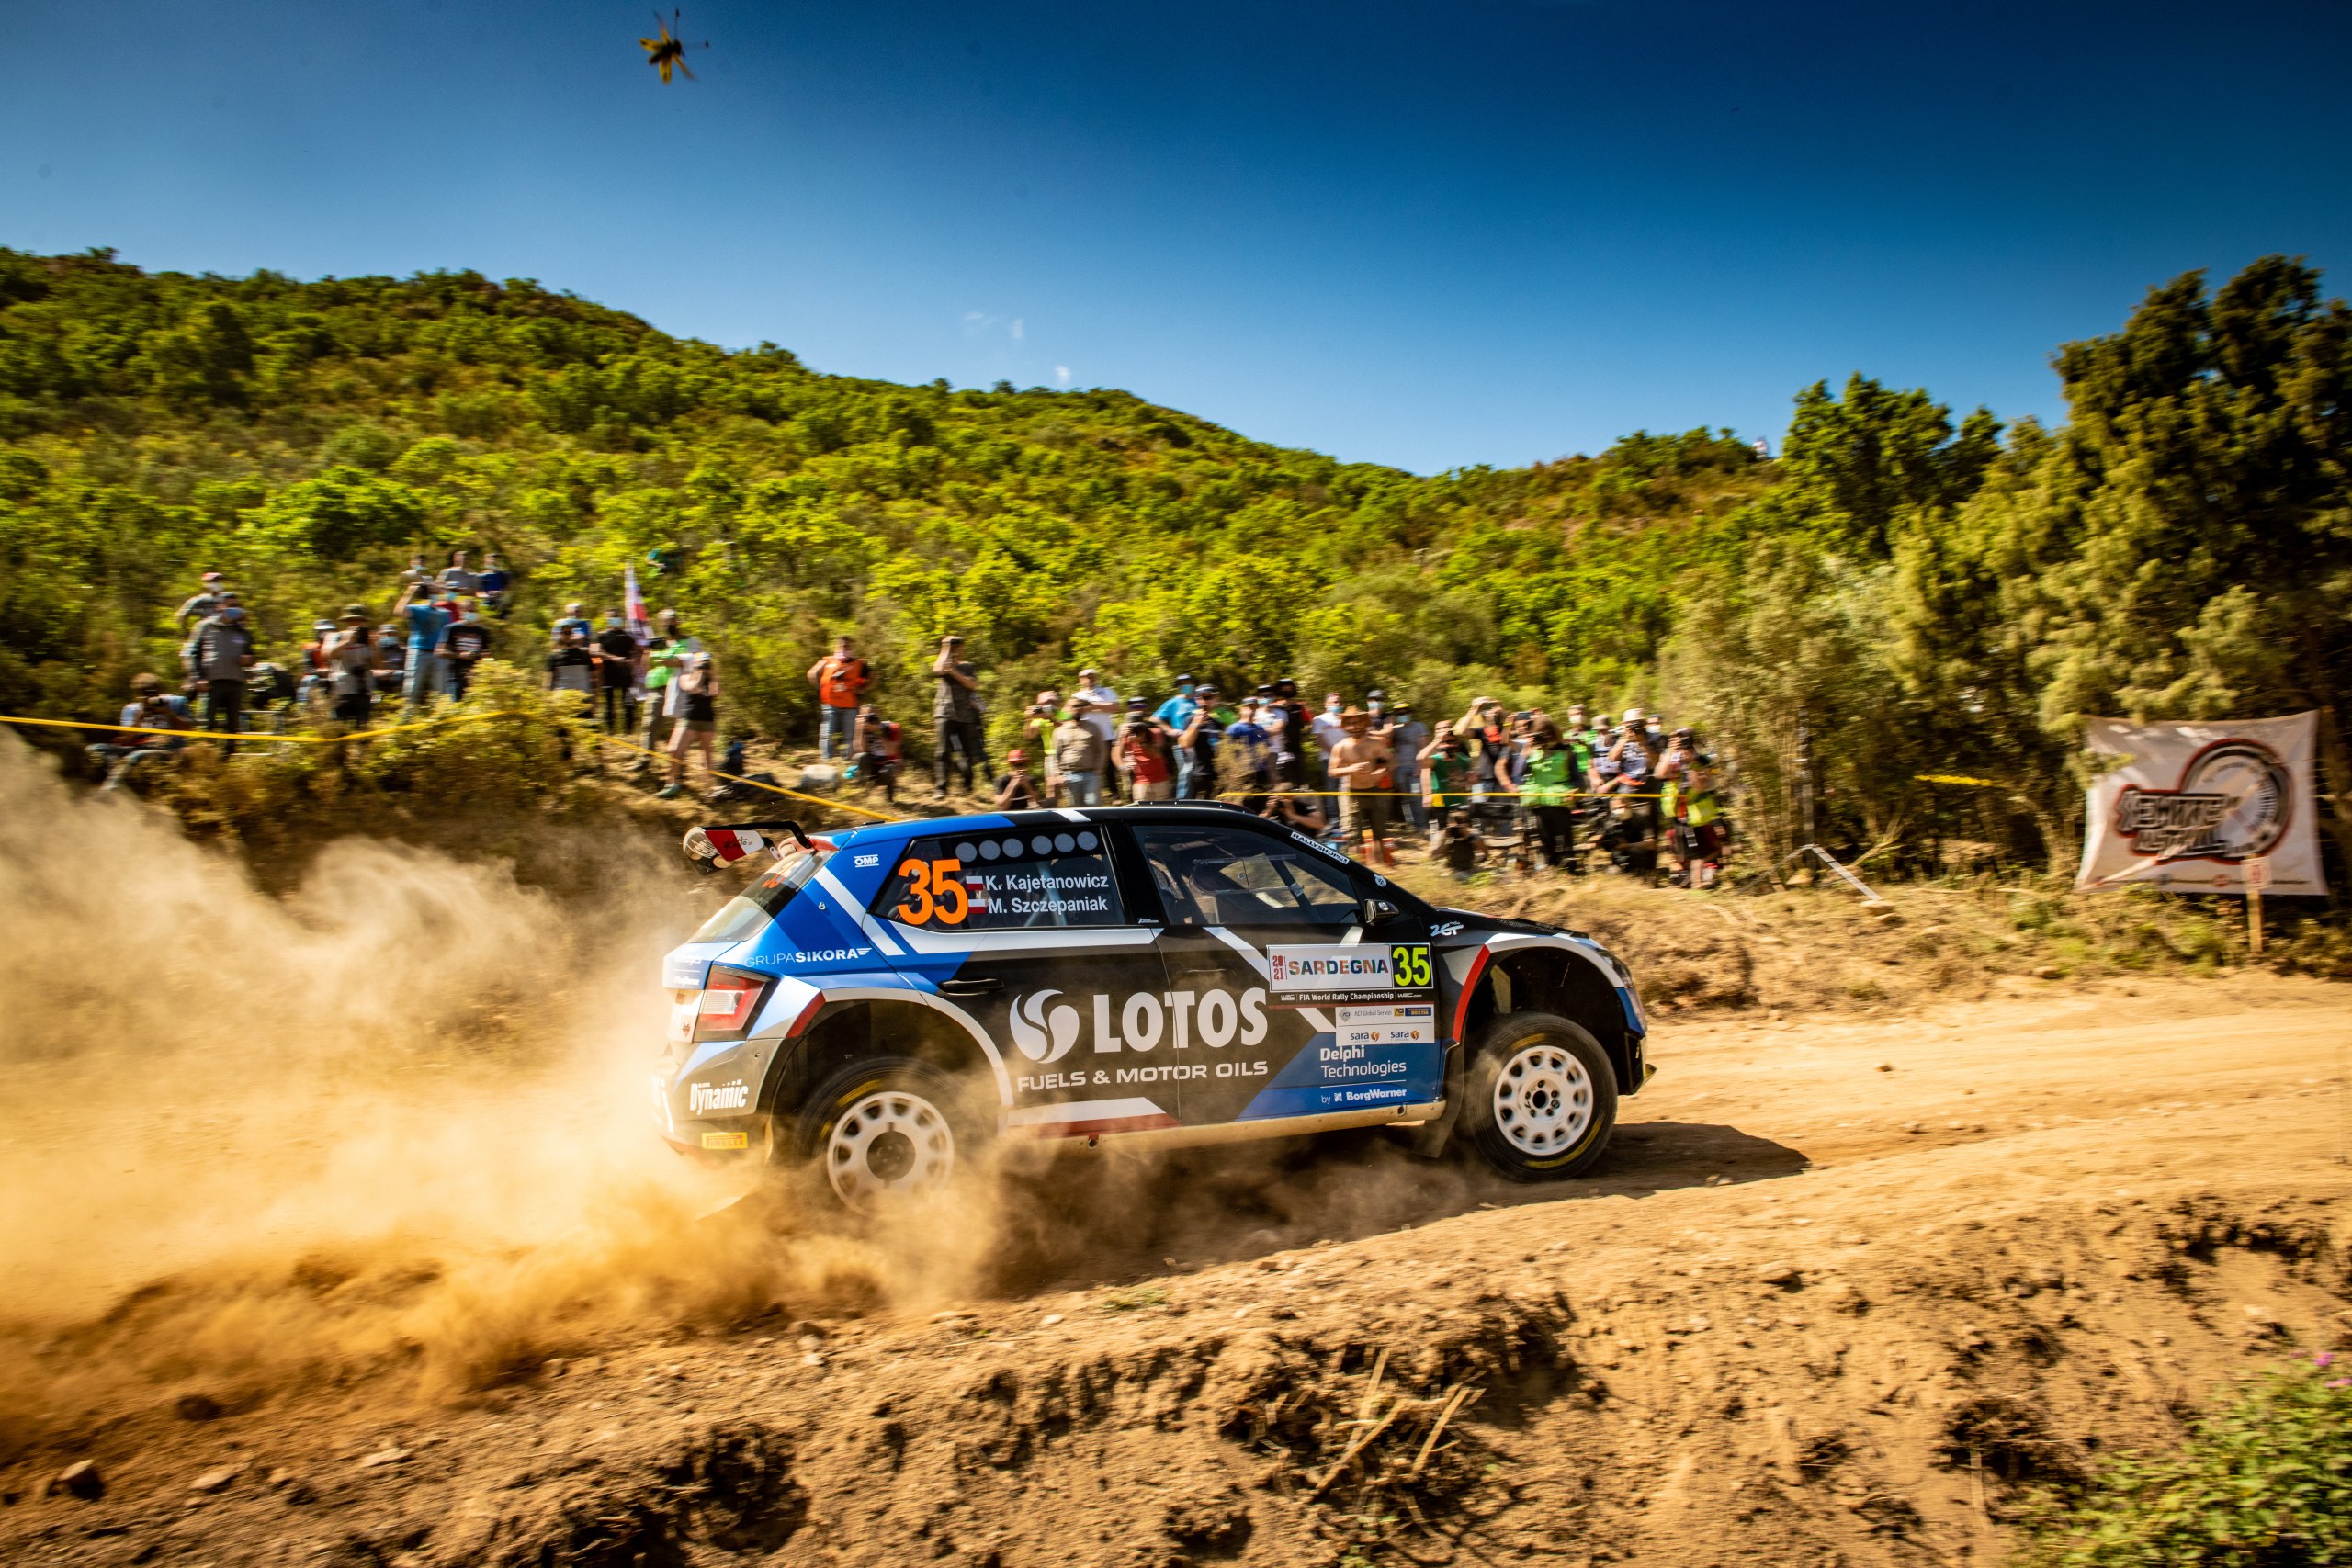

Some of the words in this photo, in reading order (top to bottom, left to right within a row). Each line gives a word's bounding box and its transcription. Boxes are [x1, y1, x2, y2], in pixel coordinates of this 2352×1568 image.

[854, 856, 879, 866] OMP
[897, 858, 969, 925] 35
[986, 875, 1002, 891] K.
[1006, 874, 1109, 893] Kajetanowicz
[989, 898, 1008, 914] M.
[1012, 896, 1108, 915] Szczepaniak
[1288, 959, 1389, 976] SARDEGNA
[1392, 946, 1430, 987] 35
[1299, 994, 1310, 1002] FIA
[1311, 993, 1330, 1001] World
[1332, 992, 1349, 1002] Rally
[1350, 991, 1394, 1002] Championship
[1093, 987, 1268, 1053] LOTOS
[1350, 1032, 1370, 1041] sara
[1390, 1030, 1409, 1039] sara
[1320, 1045, 1364, 1062] Delphi
[1017, 1070, 1086, 1092] FUELS
[1093, 1070, 1110, 1084] &
[1116, 1064, 1208, 1083] MOTOR
[1216, 1061, 1268, 1077] OILS
[1320, 1059, 1407, 1078] Technologies
[690, 1079, 749, 1115] Dynamic
[1321, 1095, 1331, 1104] by
[1346, 1089, 1407, 1101] BorgWarner
